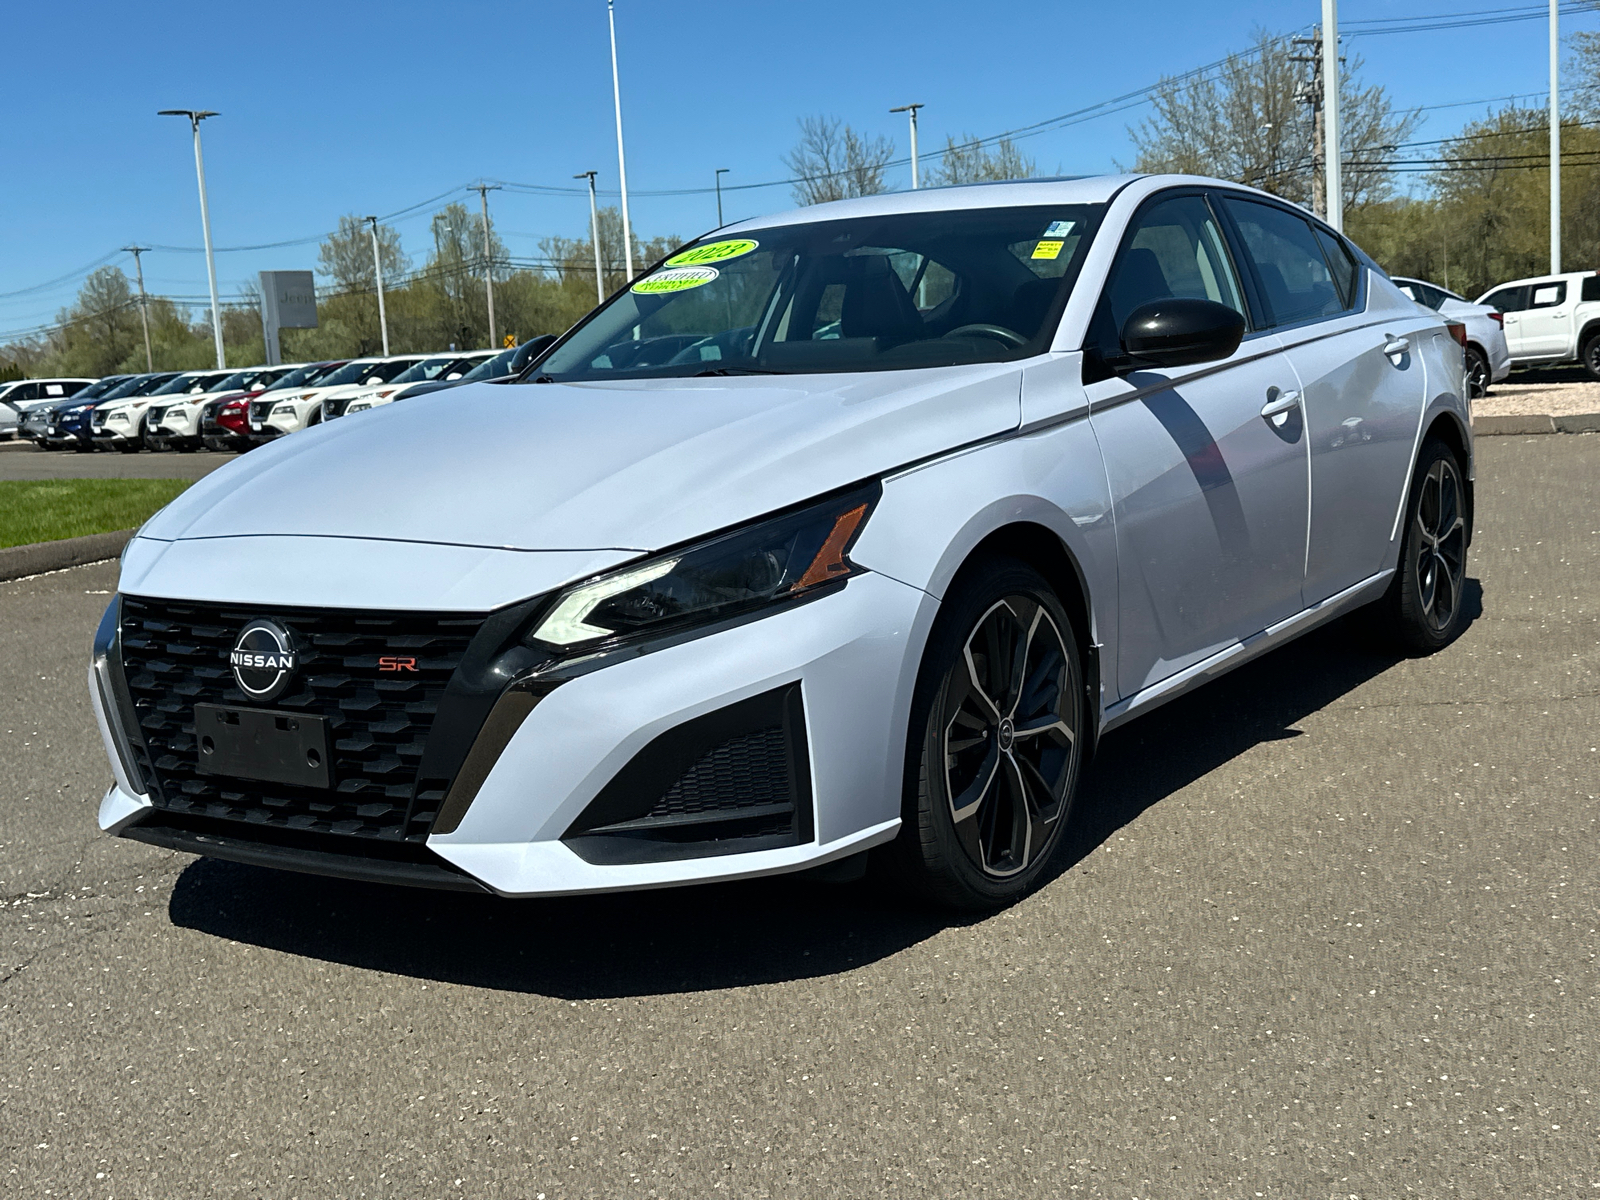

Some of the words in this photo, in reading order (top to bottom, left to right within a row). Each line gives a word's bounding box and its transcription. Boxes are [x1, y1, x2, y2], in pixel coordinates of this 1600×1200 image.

[673, 243, 747, 264] 2023
[645, 271, 713, 283] CERTIFIED
[280, 291, 312, 305] Jeep
[230, 652, 293, 668] NISSAN
[378, 656, 420, 672] SR
